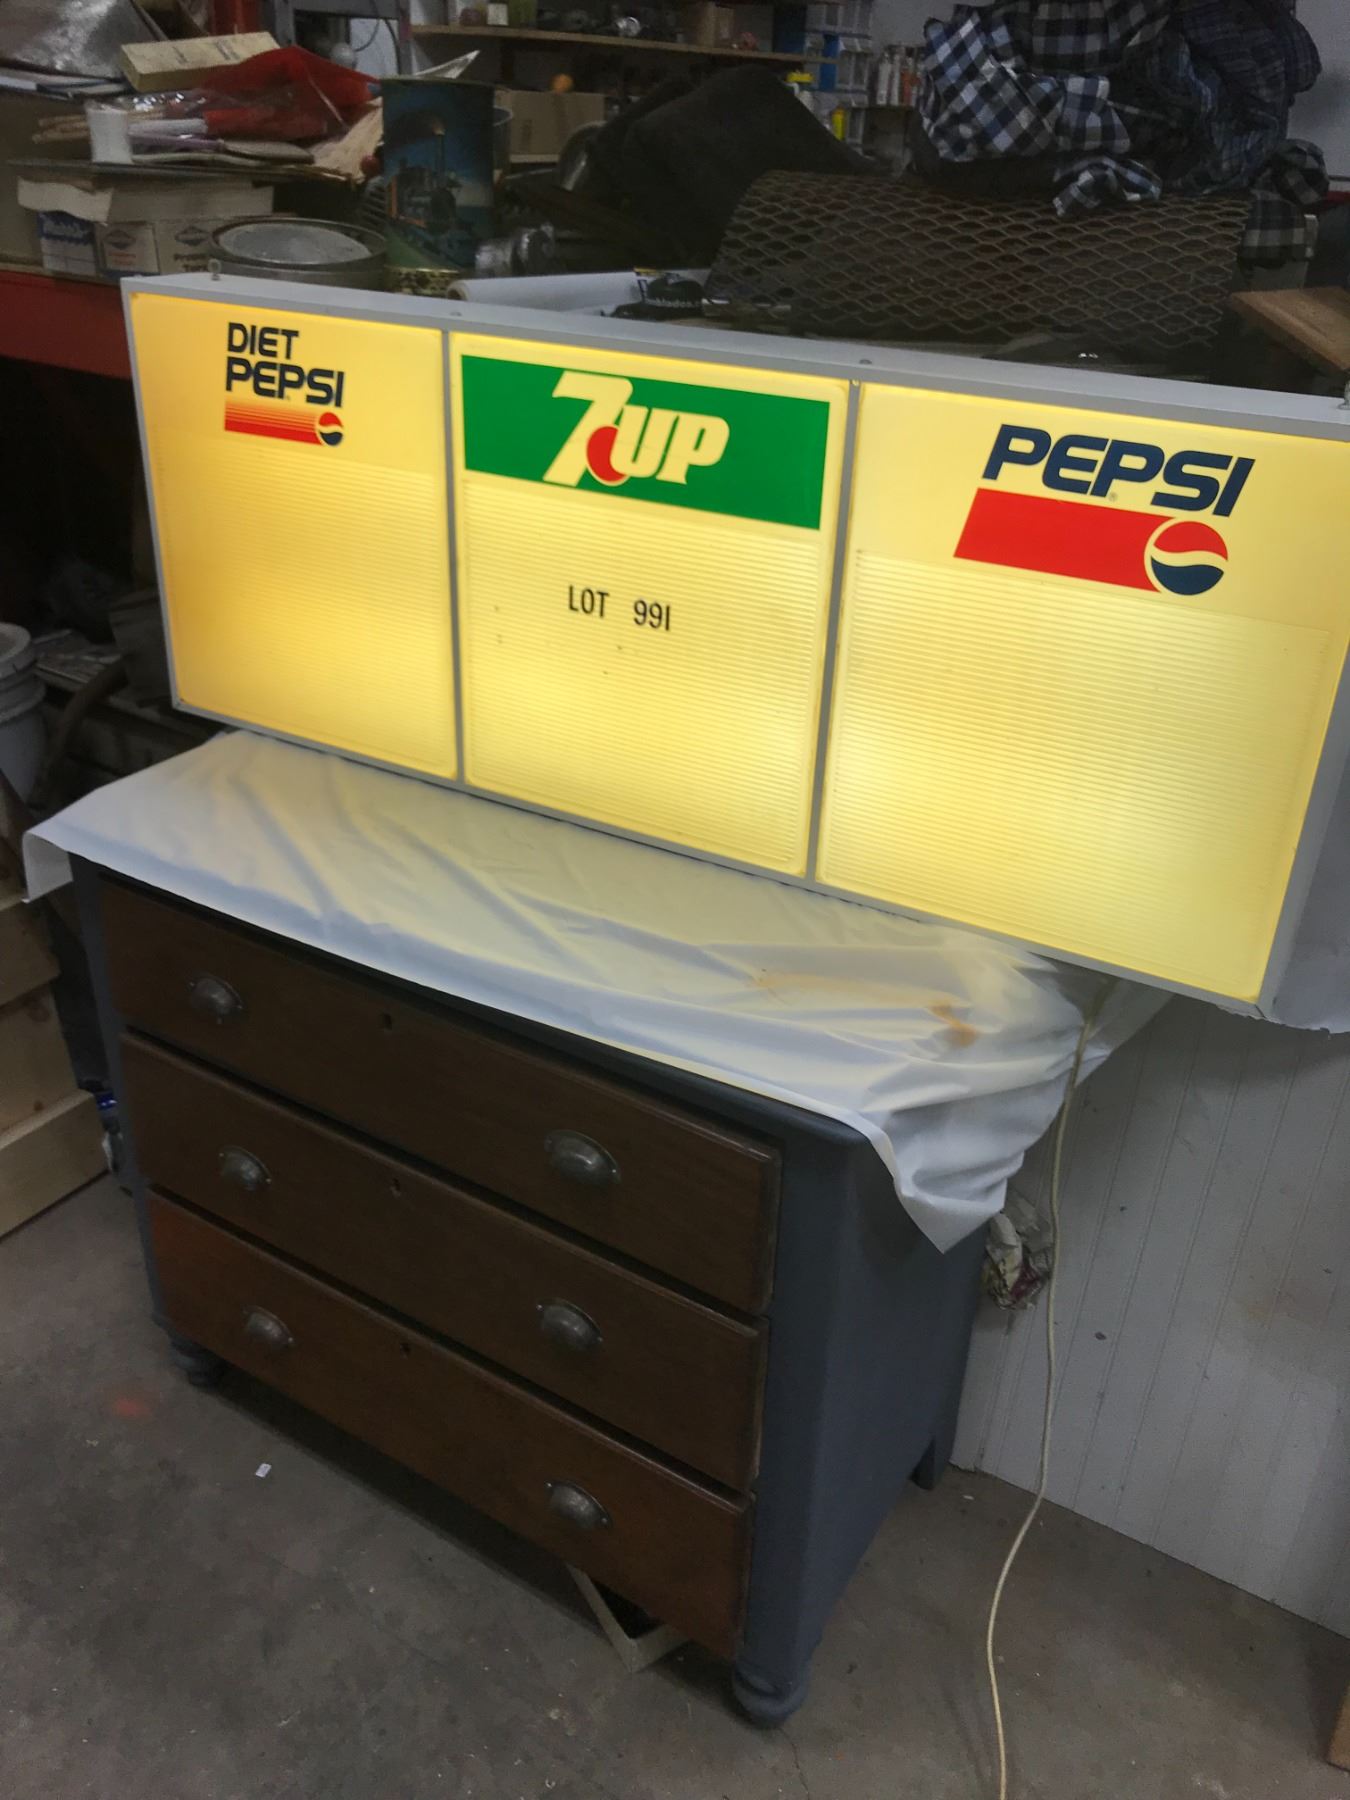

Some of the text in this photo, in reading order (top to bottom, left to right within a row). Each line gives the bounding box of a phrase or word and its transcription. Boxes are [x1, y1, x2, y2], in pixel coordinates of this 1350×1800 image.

[227, 322, 299, 360] DIET
[225, 356, 345, 408] PEPSI
[542, 370, 730, 487] 7UP
[981, 423, 1256, 517] PEPSI
[568, 585, 671, 631] LOT 991
